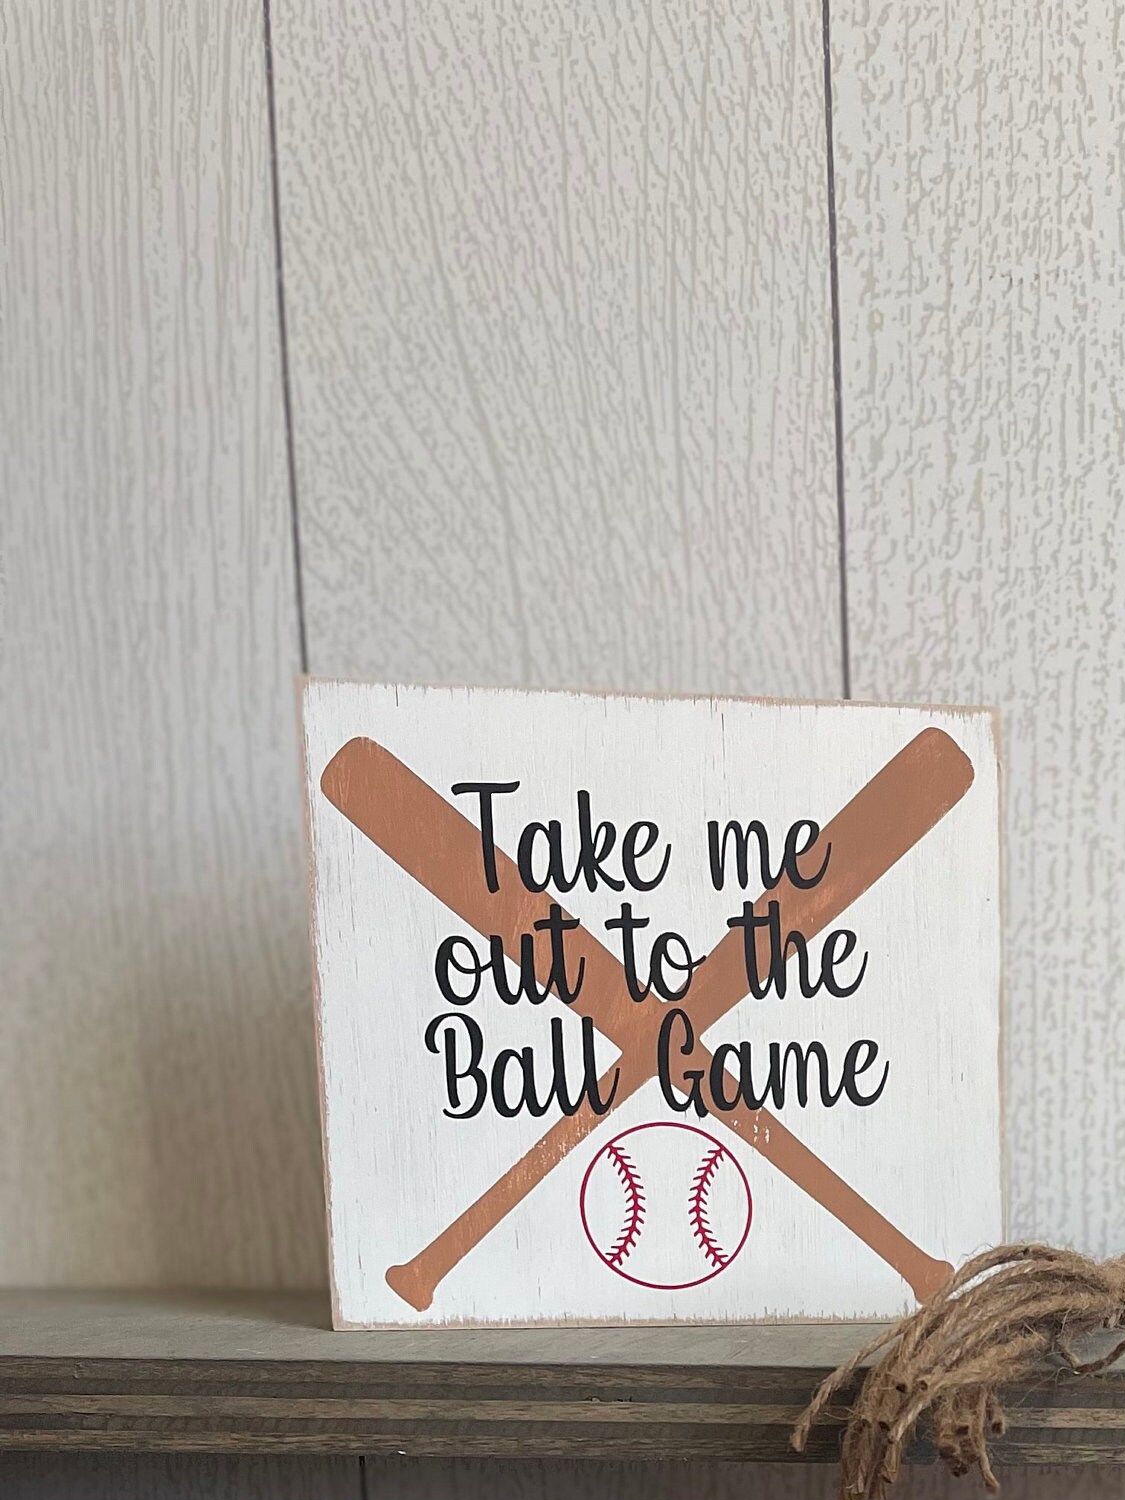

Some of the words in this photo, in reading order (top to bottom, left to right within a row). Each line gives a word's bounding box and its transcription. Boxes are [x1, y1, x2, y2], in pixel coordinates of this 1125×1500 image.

[450, 780, 672, 894] Take
[707, 819, 832, 891] me
[434, 903, 586, 1006] out
[604, 902, 707, 1003] to
[726, 899, 869, 1000] the
[424, 1012, 621, 1120] Ball
[657, 1008, 890, 1118] Game
